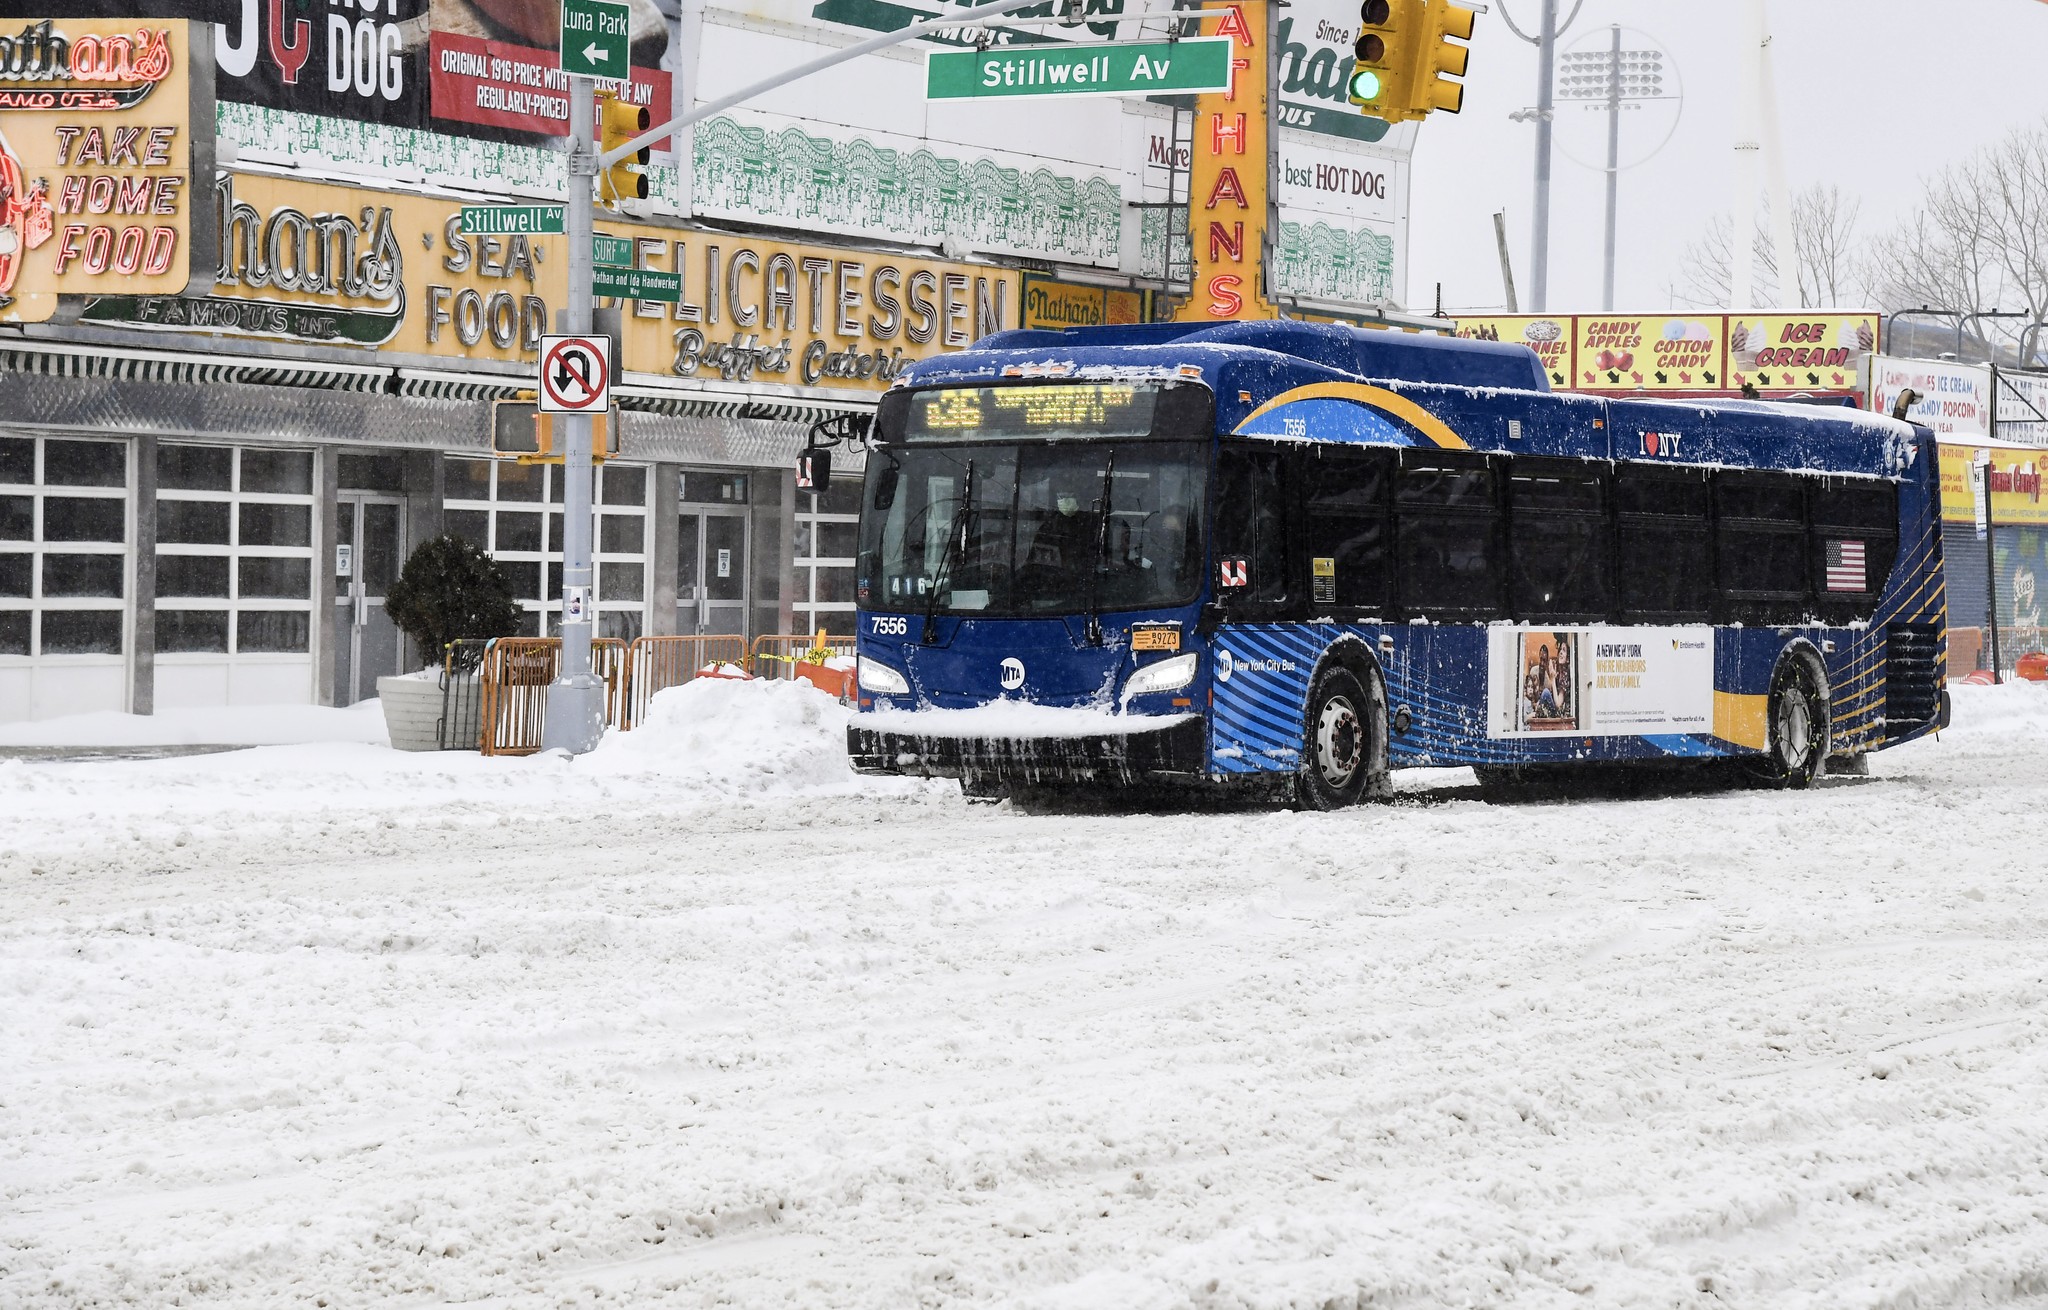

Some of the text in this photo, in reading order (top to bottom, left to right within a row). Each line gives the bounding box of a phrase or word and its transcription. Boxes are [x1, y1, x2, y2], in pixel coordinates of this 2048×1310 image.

[564, 7, 627, 36] Luna Park
[1316, 19, 1349, 45] Since
[0, 19, 173, 82] athan's
[328, 13, 404, 101] DOG
[441, 50, 489, 79] ORIGINAL
[491, 58, 512, 82] 1916
[514, 62, 542, 88] PRICE
[544, 67, 568, 91] WITH
[619, 82, 632, 102] OF
[633, 83, 653, 105] ANY
[981, 54, 1171, 87] Stillwell Av
[0, 93, 95, 107] AMOUS
[476, 85, 568, 120] REGULARLY-PRICED
[55, 126, 177, 166] TAKE
[1148, 135, 1189, 167] More
[1285, 159, 1312, 187] best
[1316, 164, 1350, 194] HOT
[1352, 168, 1385, 200] DOG
[56, 175, 185, 216] HOME
[465, 208, 562, 234] Stillwell Av
[216, 170, 403, 298] han's
[54, 225, 178, 276] FOOD
[443, 213, 536, 281] SEA
[594, 240, 628, 261] SURF AV
[592, 271, 678, 289] Nathan and Ida Handwerker
[594, 233, 1007, 348] ELICATESSEN
[630, 288, 640, 296] Way
[138, 299, 289, 333] FAMOUS
[1028, 287, 1101, 326] Nathan's
[426, 284, 548, 352] FOOD
[1588, 321, 1641, 335] CANDY
[1584, 334, 1642, 348] APPLES
[1780, 323, 1827, 343] ICE
[672, 327, 916, 384] Buffet Cateri
[1515, 341, 1567, 355] NNEL
[1653, 339, 1713, 353] COTTON
[1540, 355, 1560, 369] KE
[1657, 354, 1710, 368] CANDY
[1755, 347, 1850, 367] CREAM
[1937, 375, 1947, 392] ICE
[1949, 376, 1973, 394] CREAM
[1943, 401, 1976, 418] POPCORN
[1283, 418, 1306, 437] 7556
[1939, 422, 1954, 433] YEAR
[2014, 463, 2041, 504] Candy
[871, 616, 907, 635] 7556
[1596, 645, 1641, 657] A NEW NEW YORK
[1000, 664, 1021, 683] MTA
[1234, 659, 1295, 673] New York City Bus
[1596, 660, 1646, 672] WHERE NEIGHBORS
[1596, 676, 1607, 688] ARE
[1608, 676, 1620, 688] NOW
